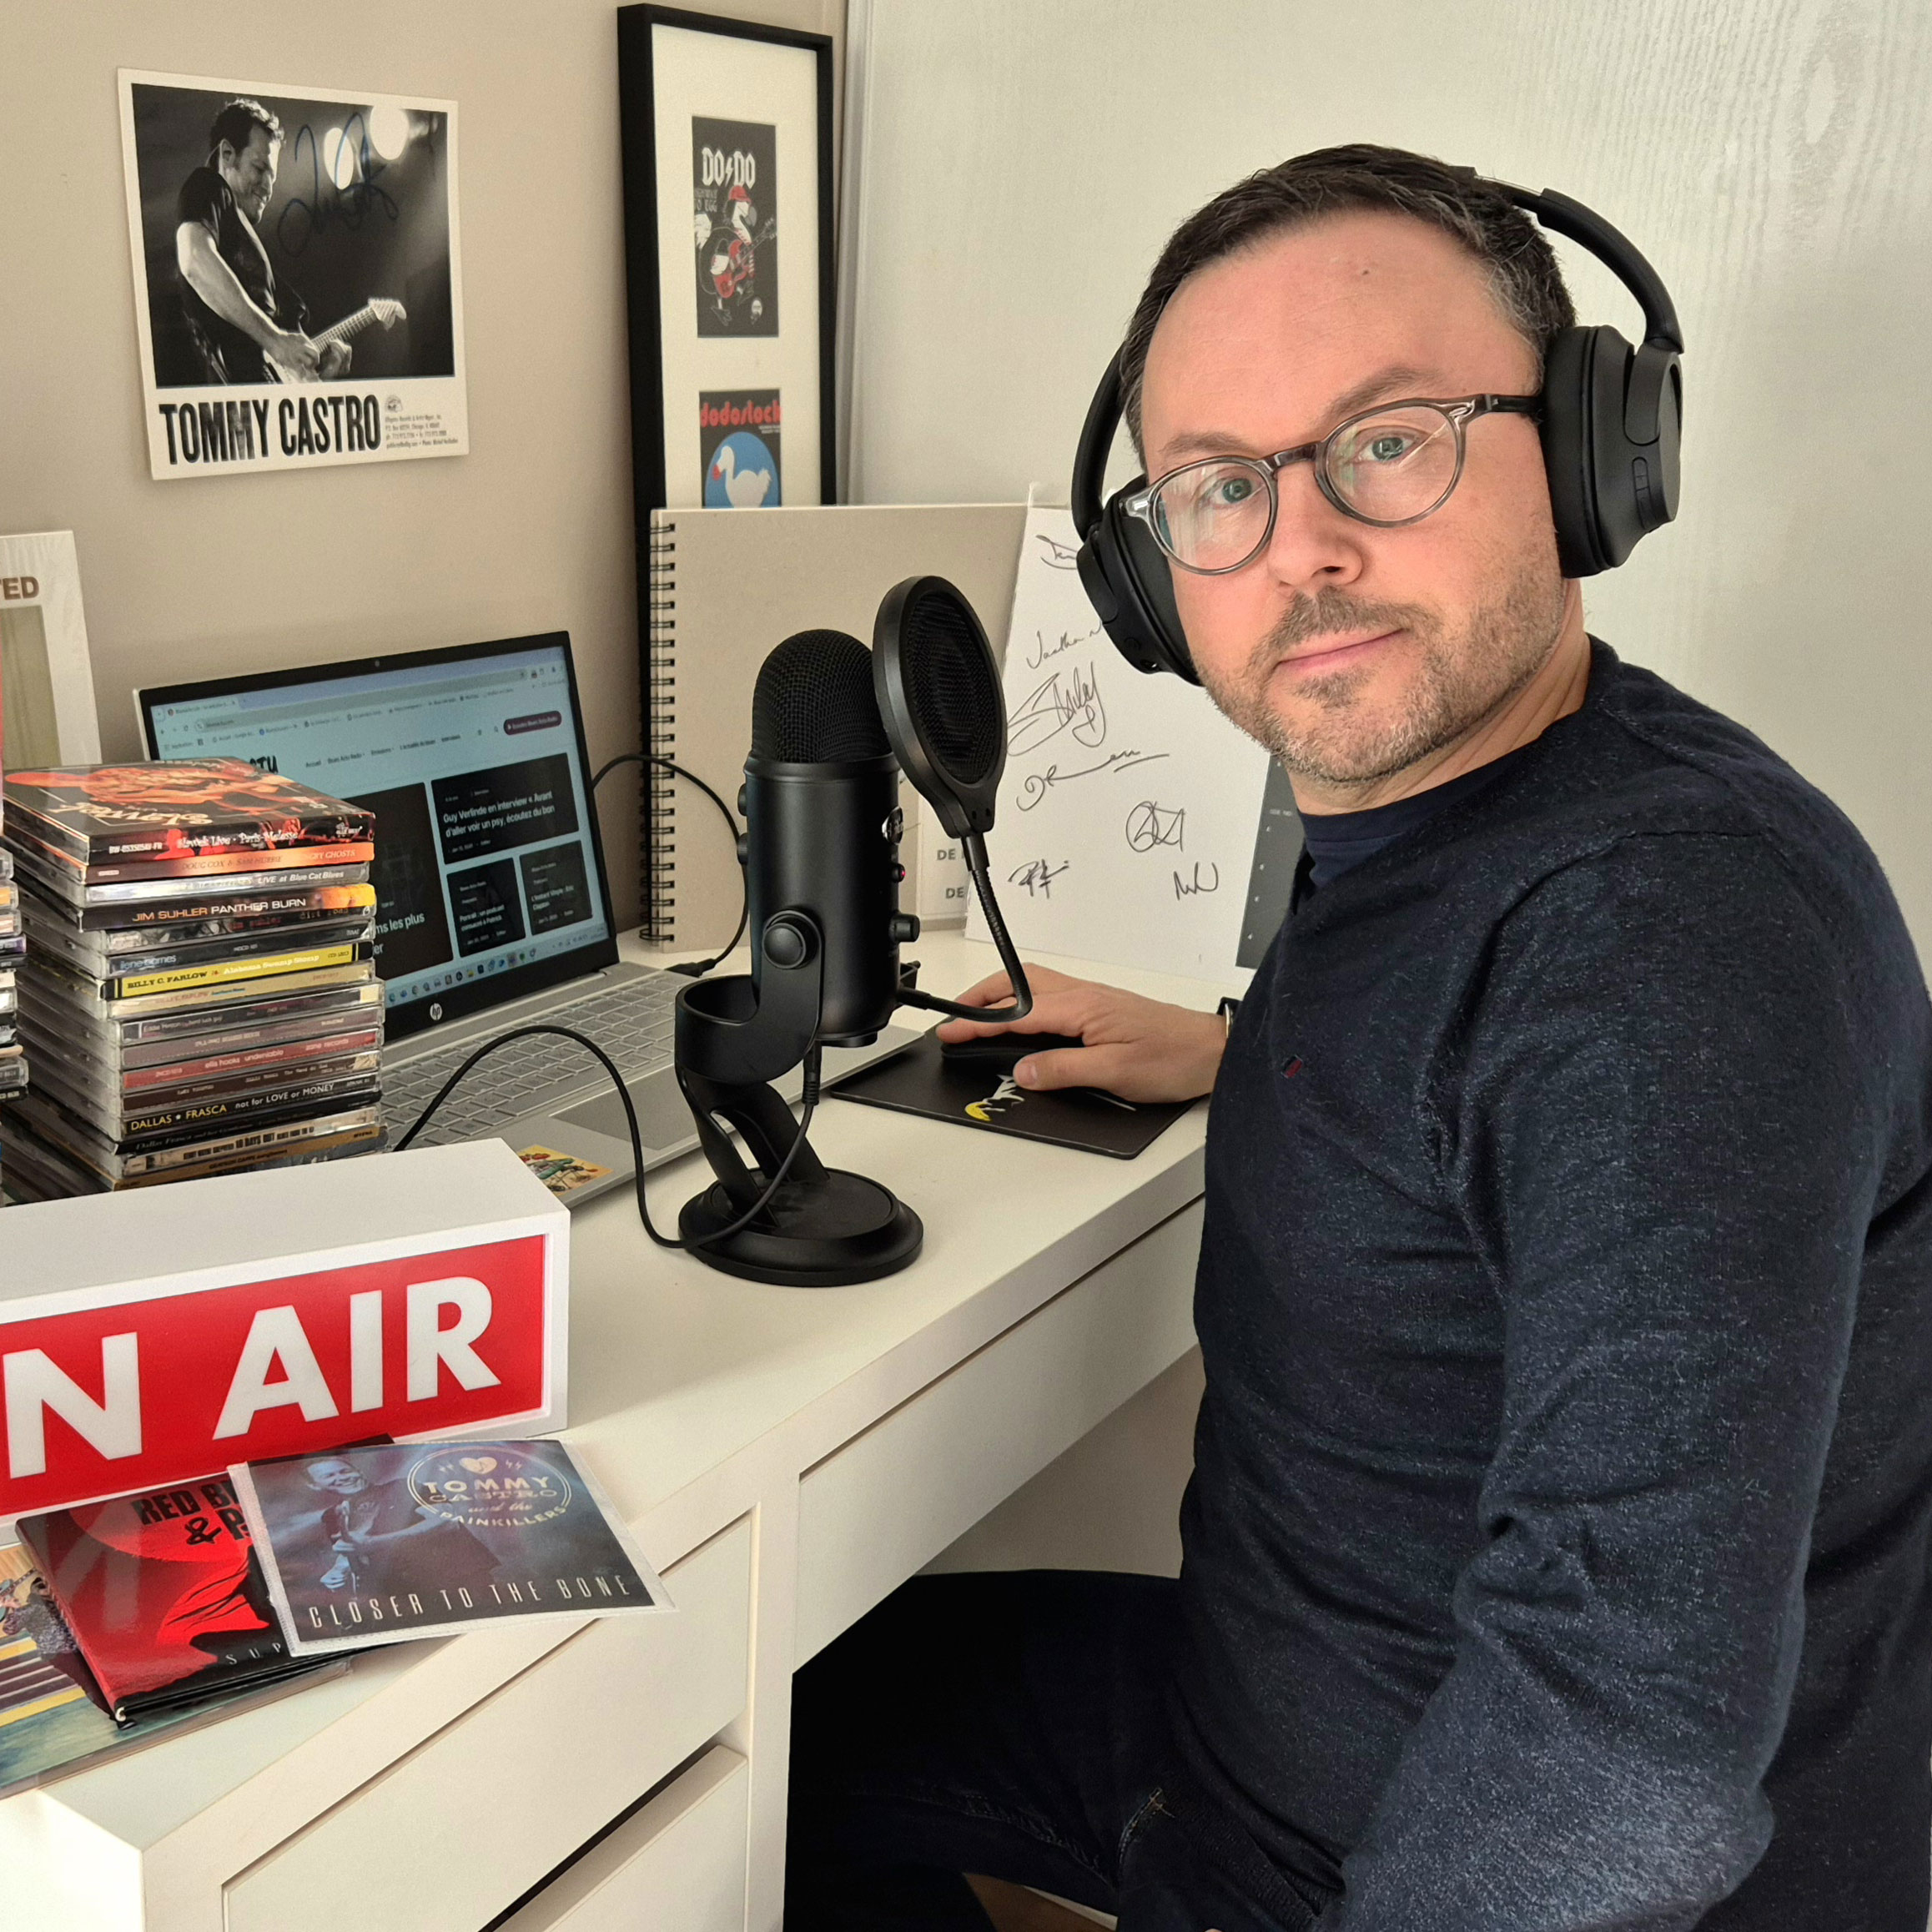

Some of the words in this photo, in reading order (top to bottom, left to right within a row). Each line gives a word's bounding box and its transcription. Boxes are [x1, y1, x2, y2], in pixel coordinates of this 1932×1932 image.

[158, 399, 269, 465] TOMMY
[279, 395, 381, 456] CASTRO
[0, 576, 39, 600] ED
[207, 861, 225, 869] COX
[325, 849, 355, 860] GHOSTS
[937, 848, 957, 861] DE
[258, 876, 276, 884] LIVE
[289, 873, 307, 882] Blue
[322, 871, 344, 879] Blues
[945, 887, 965, 899] DE
[133, 912, 154, 922] JIM
[158, 907, 208, 920] SUHLER
[210, 900, 269, 914] PANTHER
[272, 898, 306, 910] BURN
[389, 918, 404, 931] les
[404, 913, 425, 930] plus
[127, 979, 155, 989] BILLY
[167, 971, 208, 983] FARLOW
[223, 963, 261, 975] Alabama
[262, 959, 294, 970] Swamp
[131, 1114, 172, 1131] DALLAS
[185, 1104, 227, 1120] FRASCA
[235, 1100, 249, 1109] not
[251, 1097, 264, 1106] for
[266, 1091, 289, 1104] LOVE
[290, 1090, 300, 1099] or
[303, 1084, 335, 1097] MONEY
[212, 1276, 501, 1441] AIR
[423, 1477, 549, 1493] TOMMY
[430, 1490, 557, 1502] CASTRO
[131, 1491, 202, 1526] RED
[440, 1506, 566, 1527] PAINKILLERS
[185, 1517, 223, 1546] &
[309, 1593, 425, 1629] CLOSER
[440, 1587, 474, 1611] TO
[489, 1581, 541, 1604] THE
[556, 1575, 631, 1600] BONE
